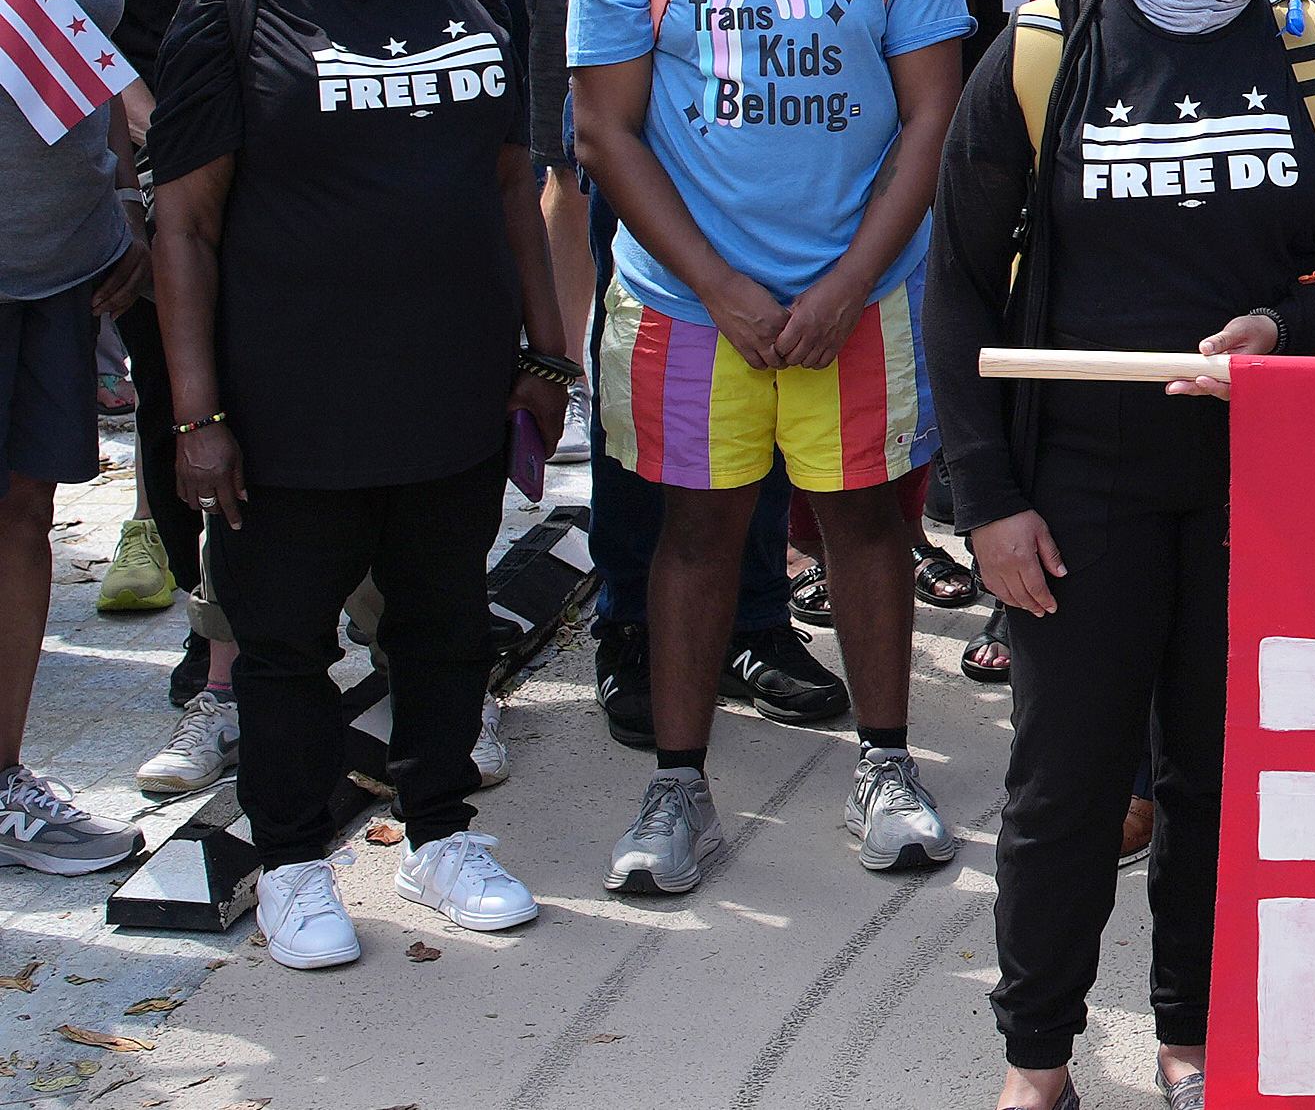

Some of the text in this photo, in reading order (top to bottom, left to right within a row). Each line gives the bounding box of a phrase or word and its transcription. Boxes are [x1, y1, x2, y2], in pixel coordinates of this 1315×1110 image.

[759, 33, 842, 77] Kids
[319, 65, 506, 112] FREE DC
[716, 79, 848, 132] Belong
[1083, 152, 1298, 199] FREE DC
